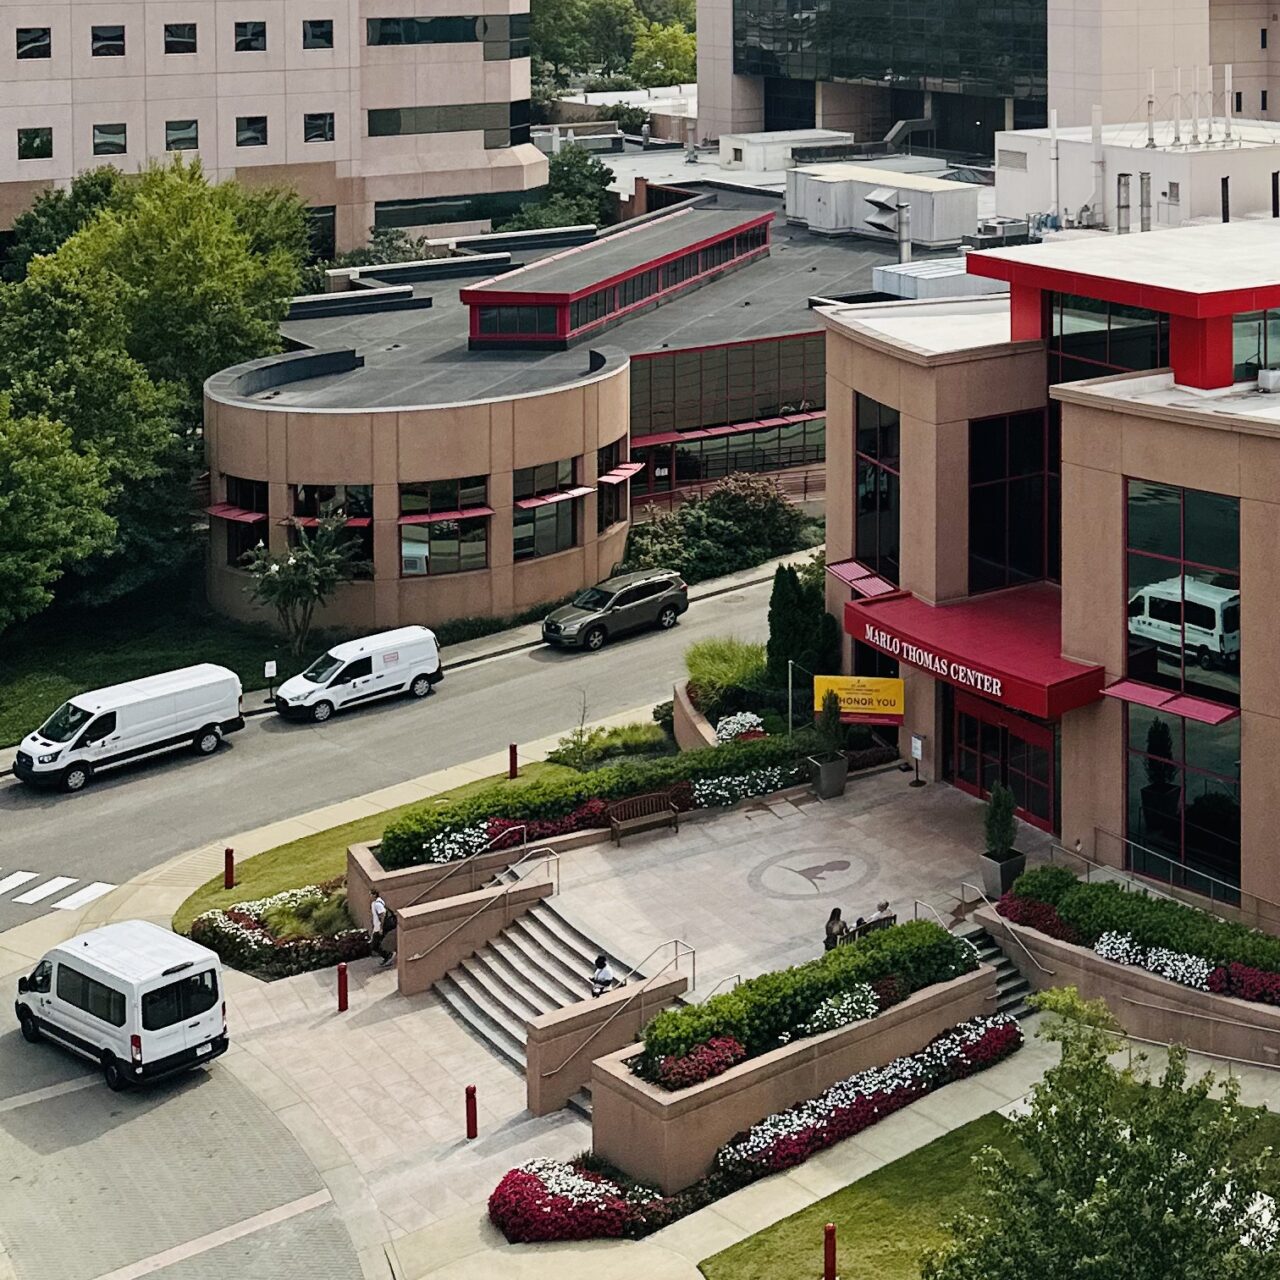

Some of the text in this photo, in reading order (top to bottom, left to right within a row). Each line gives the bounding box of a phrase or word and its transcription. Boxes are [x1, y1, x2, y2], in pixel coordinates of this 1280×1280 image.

[864, 624, 1002, 697] MARLO THOMAS CENTER
[839, 697, 896, 707] HONOR YOU
